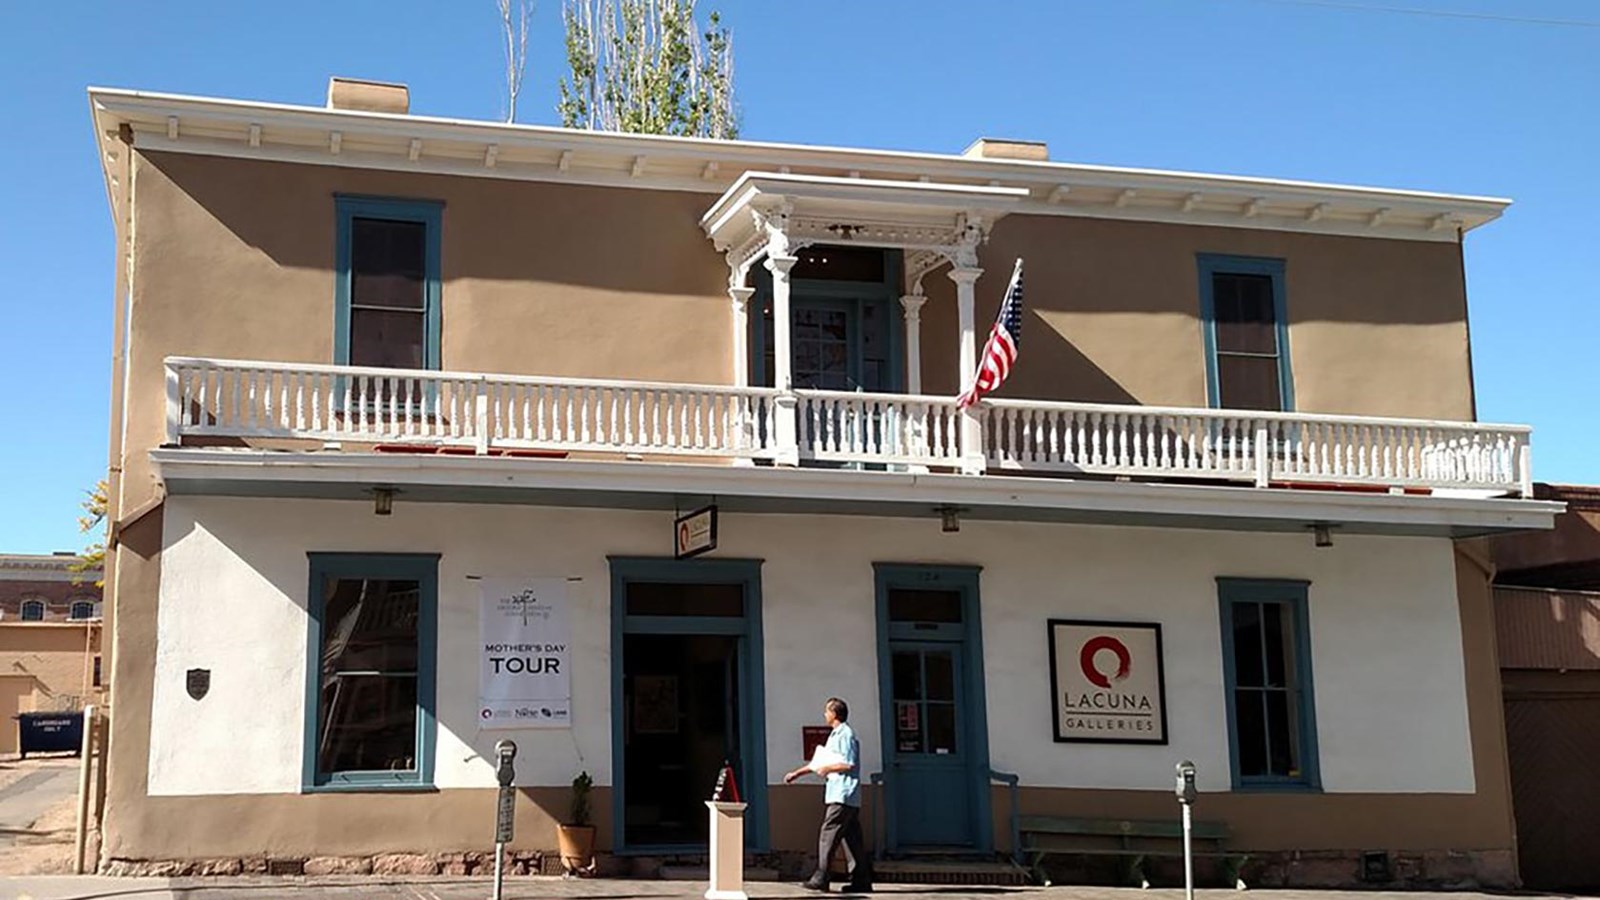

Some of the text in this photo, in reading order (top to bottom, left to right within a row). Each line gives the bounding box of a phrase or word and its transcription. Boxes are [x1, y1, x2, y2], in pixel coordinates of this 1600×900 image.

[485, 644, 566, 653] MOTHER'S DAY
[489, 657, 560, 674] TOUR
[1064, 692, 1152, 709] LACUNA
[1065, 718, 1153, 731] GALLERIES
